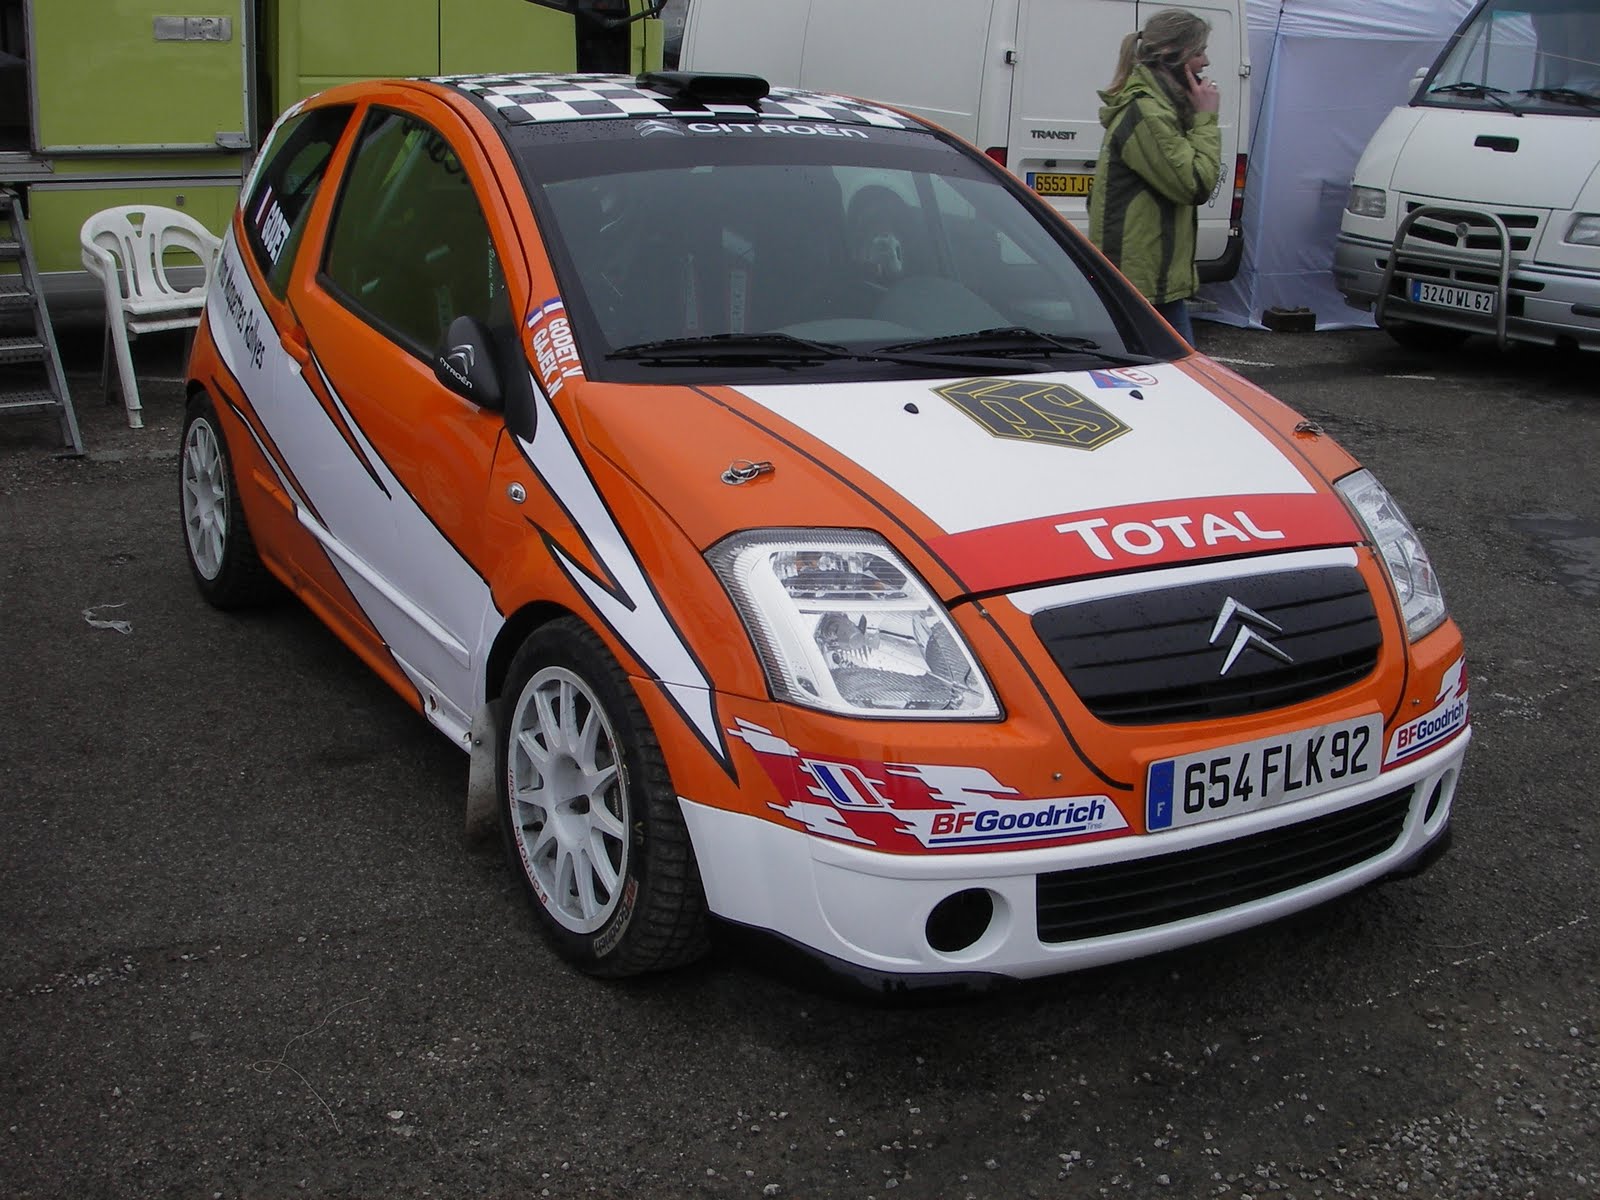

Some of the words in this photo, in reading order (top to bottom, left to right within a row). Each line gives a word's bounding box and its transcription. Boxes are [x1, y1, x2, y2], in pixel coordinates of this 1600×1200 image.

[1030, 130, 1077, 140] TRANSIT
[1036, 175, 1067, 191] 6553
[1070, 177, 1085, 192] TJ
[261, 200, 291, 265] GODET
[1423, 285, 1453, 305] 3240
[1475, 294, 1491, 312] 62
[533, 328, 559, 383] GAJEK
[548, 317, 580, 363] GODET
[1054, 510, 1286, 561] TOTAL
[1397, 699, 1464, 750] BFGoodrich
[930, 799, 1105, 836] BFGoodrich
[1157, 801, 1166, 817] F
